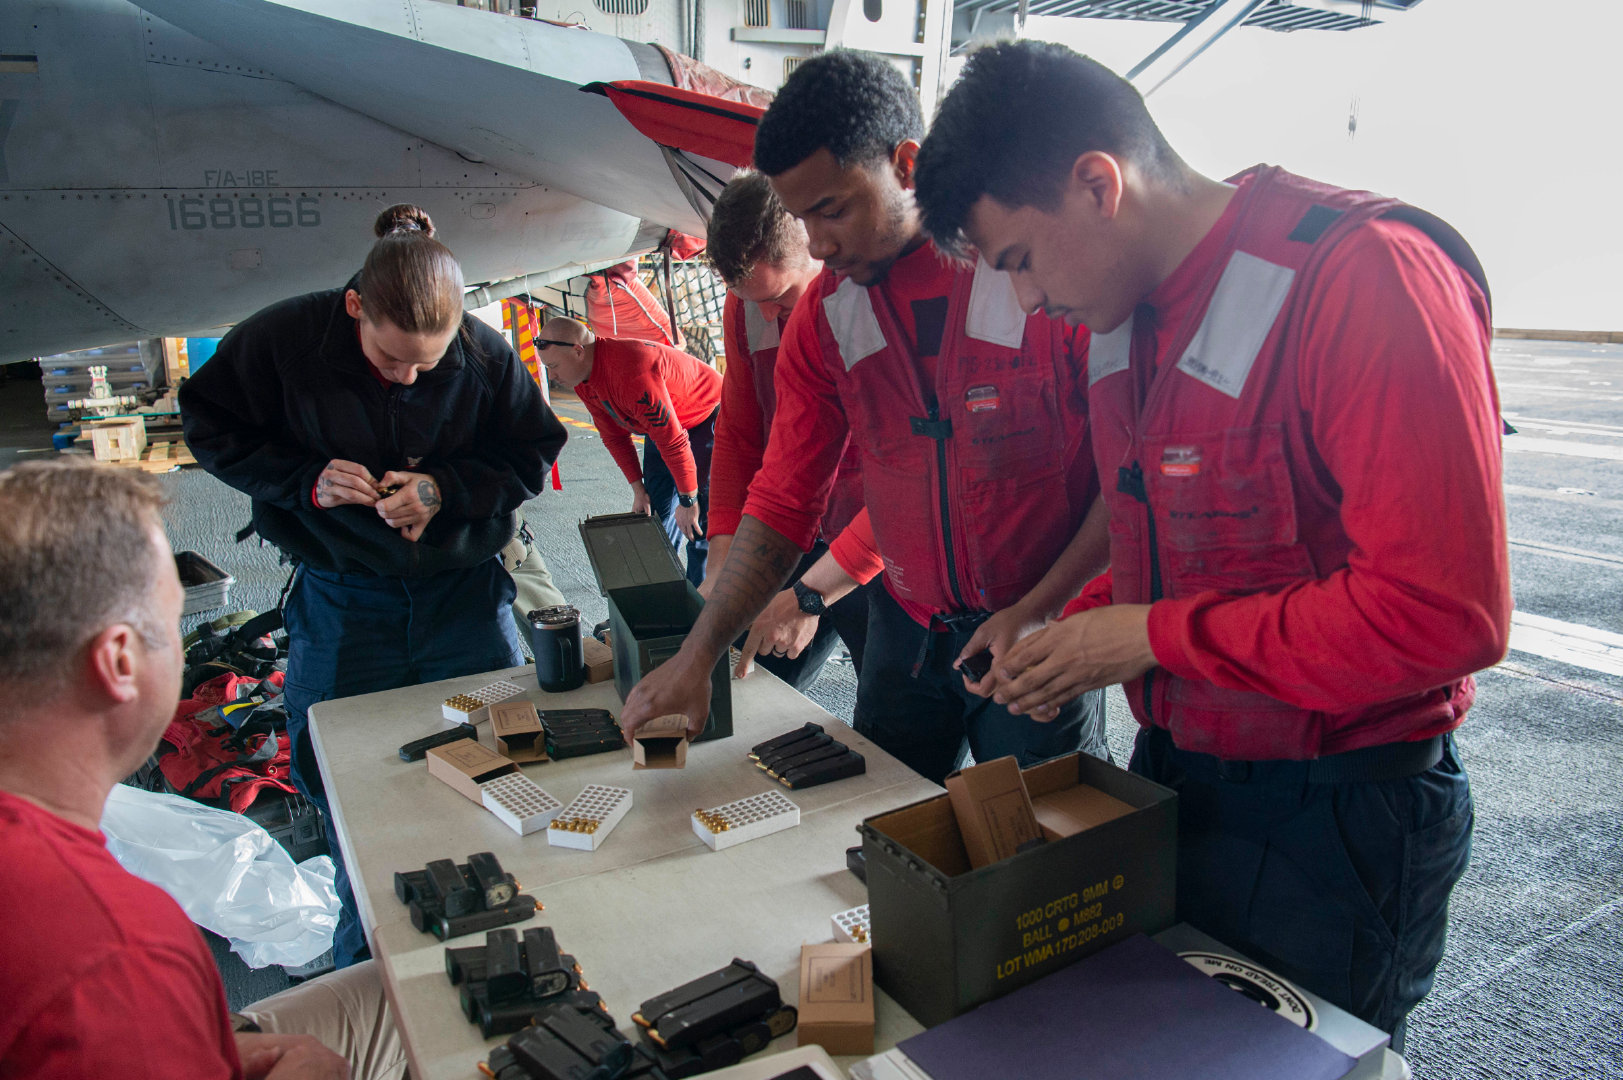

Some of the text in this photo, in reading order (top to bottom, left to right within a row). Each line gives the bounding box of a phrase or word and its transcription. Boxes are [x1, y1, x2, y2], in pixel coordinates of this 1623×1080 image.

[204, 169, 280, 187] F/A-18E
[167, 197, 321, 230] 168866
[1016, 880, 1109, 930] 1000 CRTG 9MM
[1022, 902, 1103, 948] BALL M882
[997, 955, 1022, 979] LOT
[1203, 958, 1222, 967] ME
[1224, 962, 1244, 973] ON
[1245, 971, 1281, 993] TREAD
